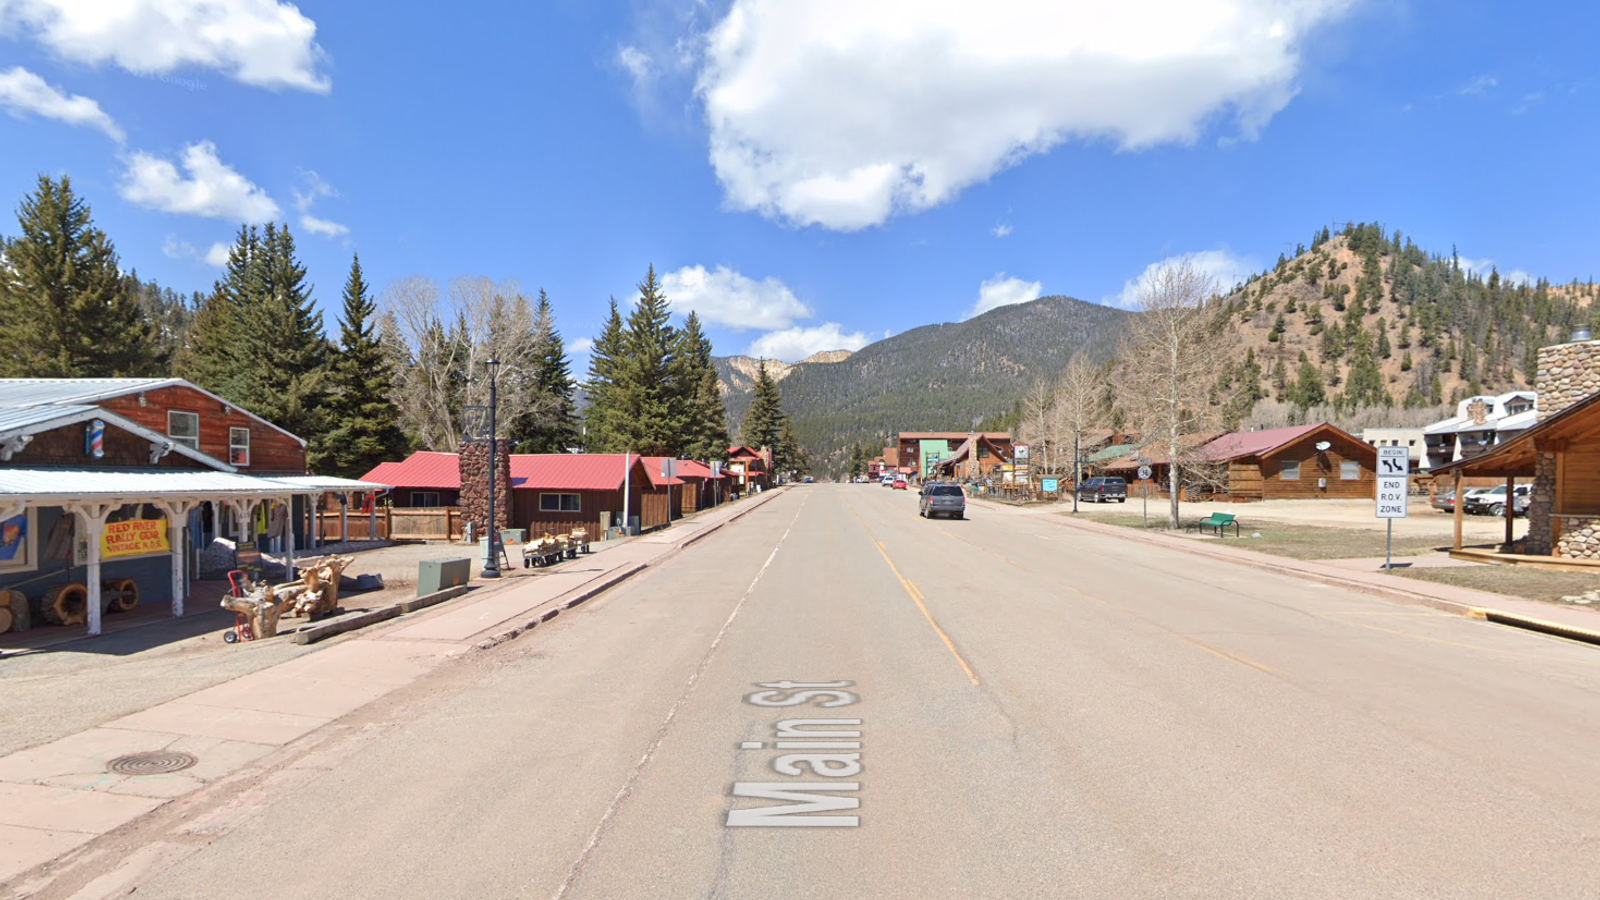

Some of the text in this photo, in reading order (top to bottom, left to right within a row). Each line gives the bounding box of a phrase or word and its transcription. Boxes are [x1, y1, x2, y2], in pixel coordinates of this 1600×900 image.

[108, 520, 156, 533] RED RIVER
[106, 532, 135, 544] RALLY
[106, 542, 140, 552] VINTAGE
